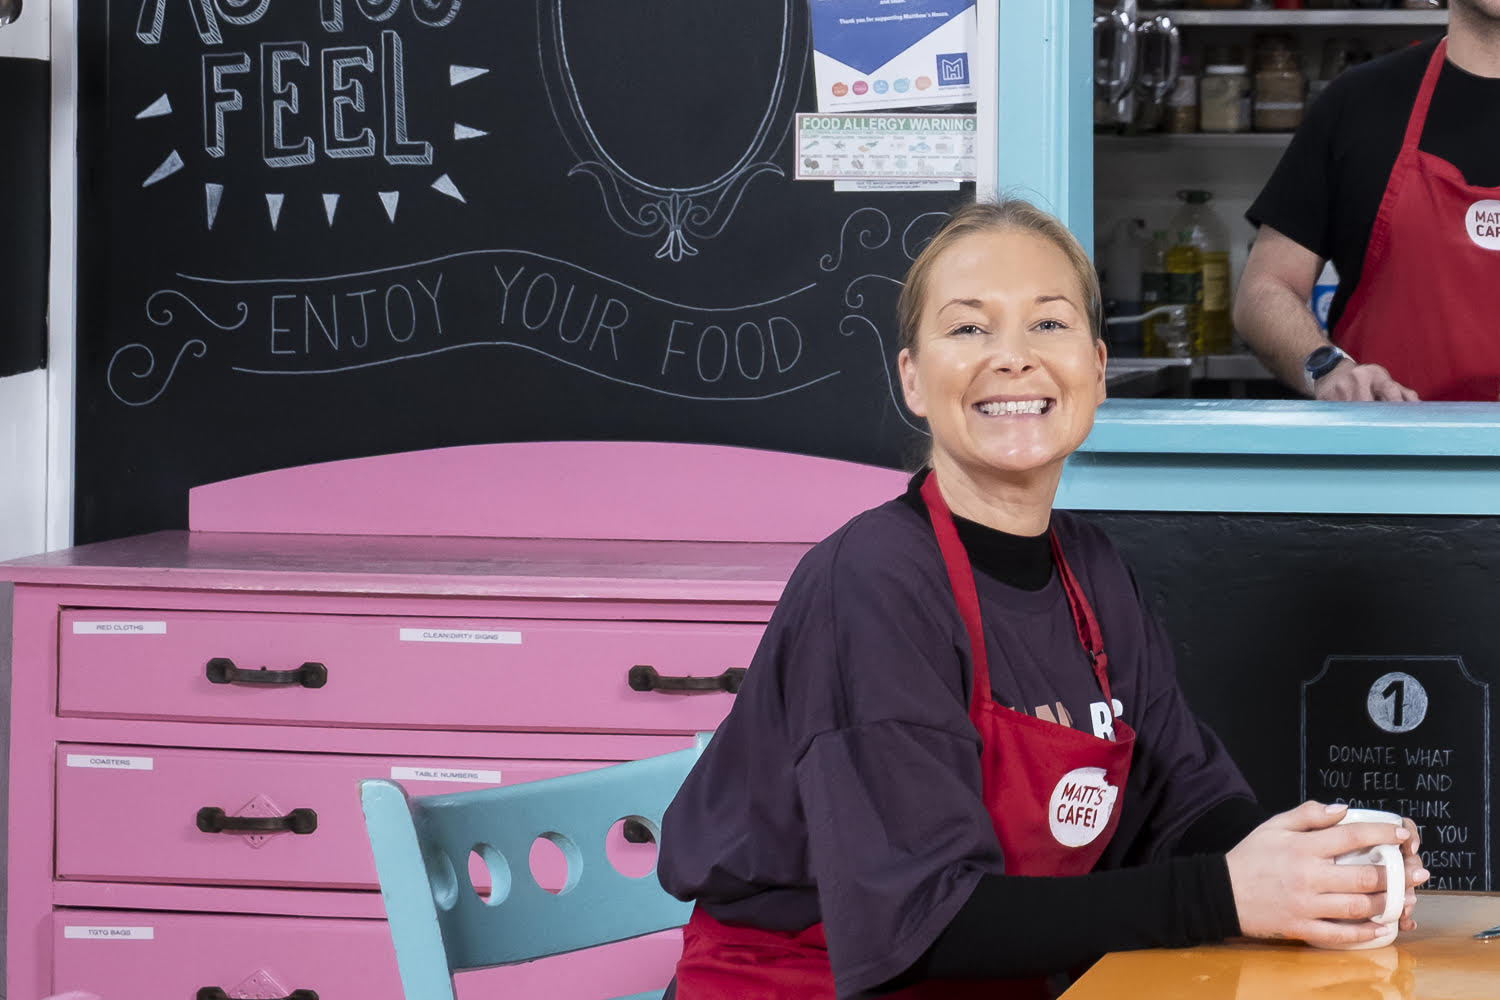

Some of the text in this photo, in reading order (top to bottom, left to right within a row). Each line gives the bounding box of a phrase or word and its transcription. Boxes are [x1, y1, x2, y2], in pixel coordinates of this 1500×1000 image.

[201, 30, 433, 167] FEEL
[802, 117, 974, 131] FOOD ALLERGY WARNING
[272, 265, 801, 382] ENJOY YOUR FOOD
[1382, 680, 1405, 727] 1
[90, 758, 131, 766] COASTERS
[1329, 744, 1454, 767] DONATE WHAT
[1319, 768, 1453, 792] YOU FEEL AND
[1061, 782, 1107, 806] MATT'S
[1056, 803, 1098, 829] CAFE!
[1400, 799, 1451, 818] THINK
[1437, 825, 1468, 843] YOU
[1421, 850, 1476, 870] OESN'T
